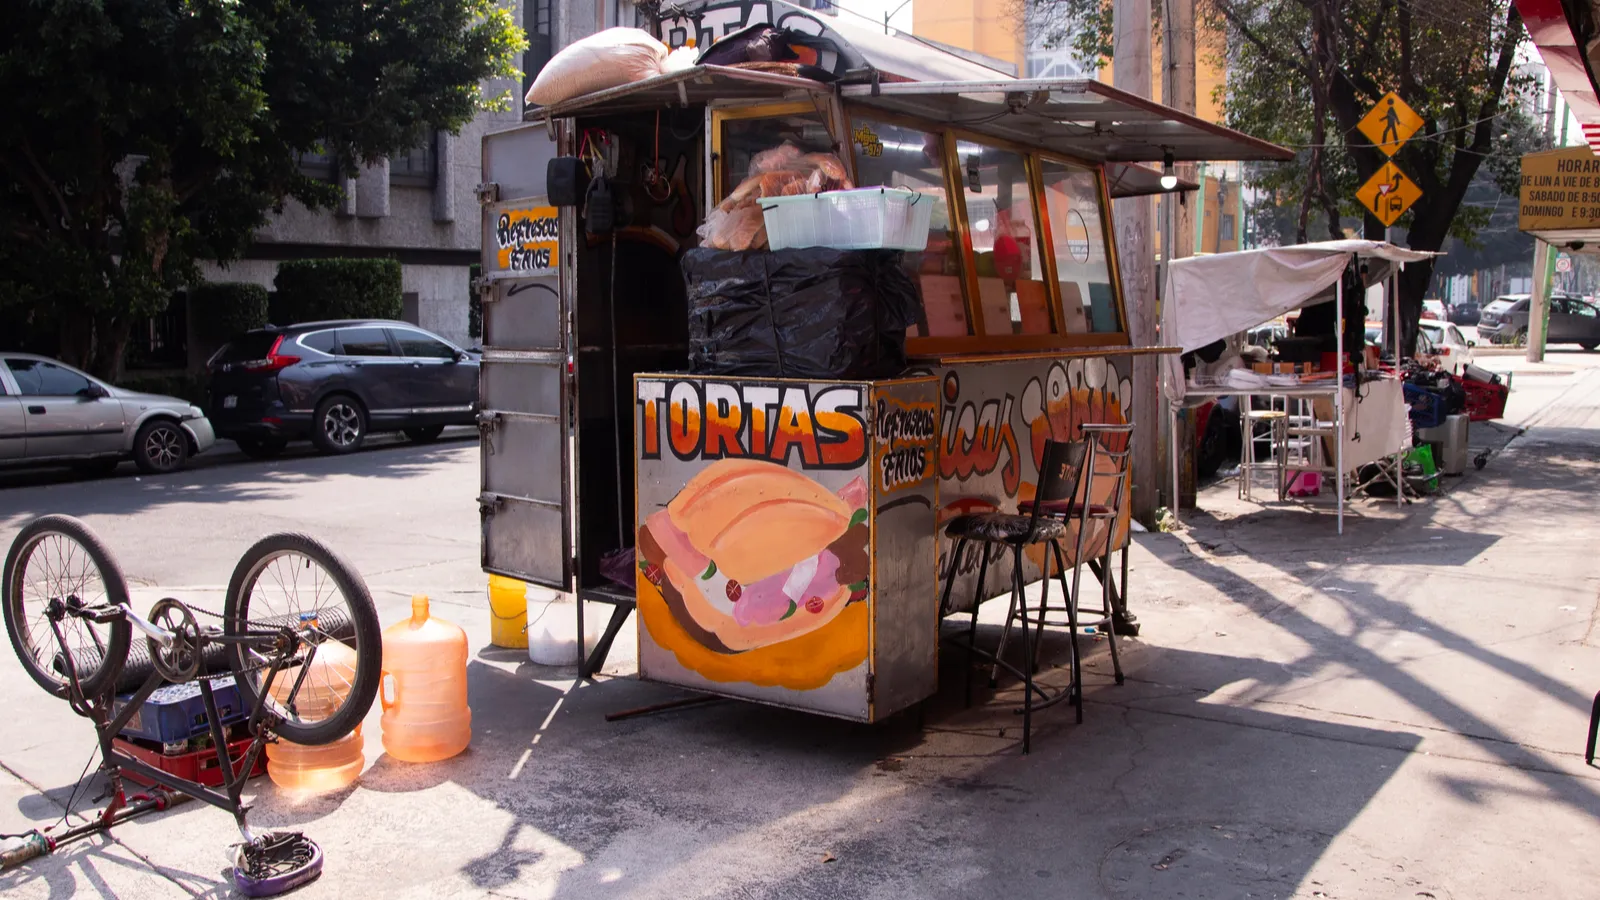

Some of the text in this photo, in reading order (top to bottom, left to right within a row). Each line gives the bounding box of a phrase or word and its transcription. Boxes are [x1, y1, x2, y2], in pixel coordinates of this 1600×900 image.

[1521, 175, 1532, 186] DE
[1534, 175, 1552, 187] LUN
[1554, 176, 1560, 187] A
[1563, 176, 1577, 187] VIE
[1580, 177, 1592, 188] DE
[1529, 190, 1566, 202] SABADO
[1567, 192, 1579, 203] DE
[1522, 205, 1564, 217] DOMINGO
[636, 379, 868, 471] TORTAS
[937, 370, 1020, 498] icas
